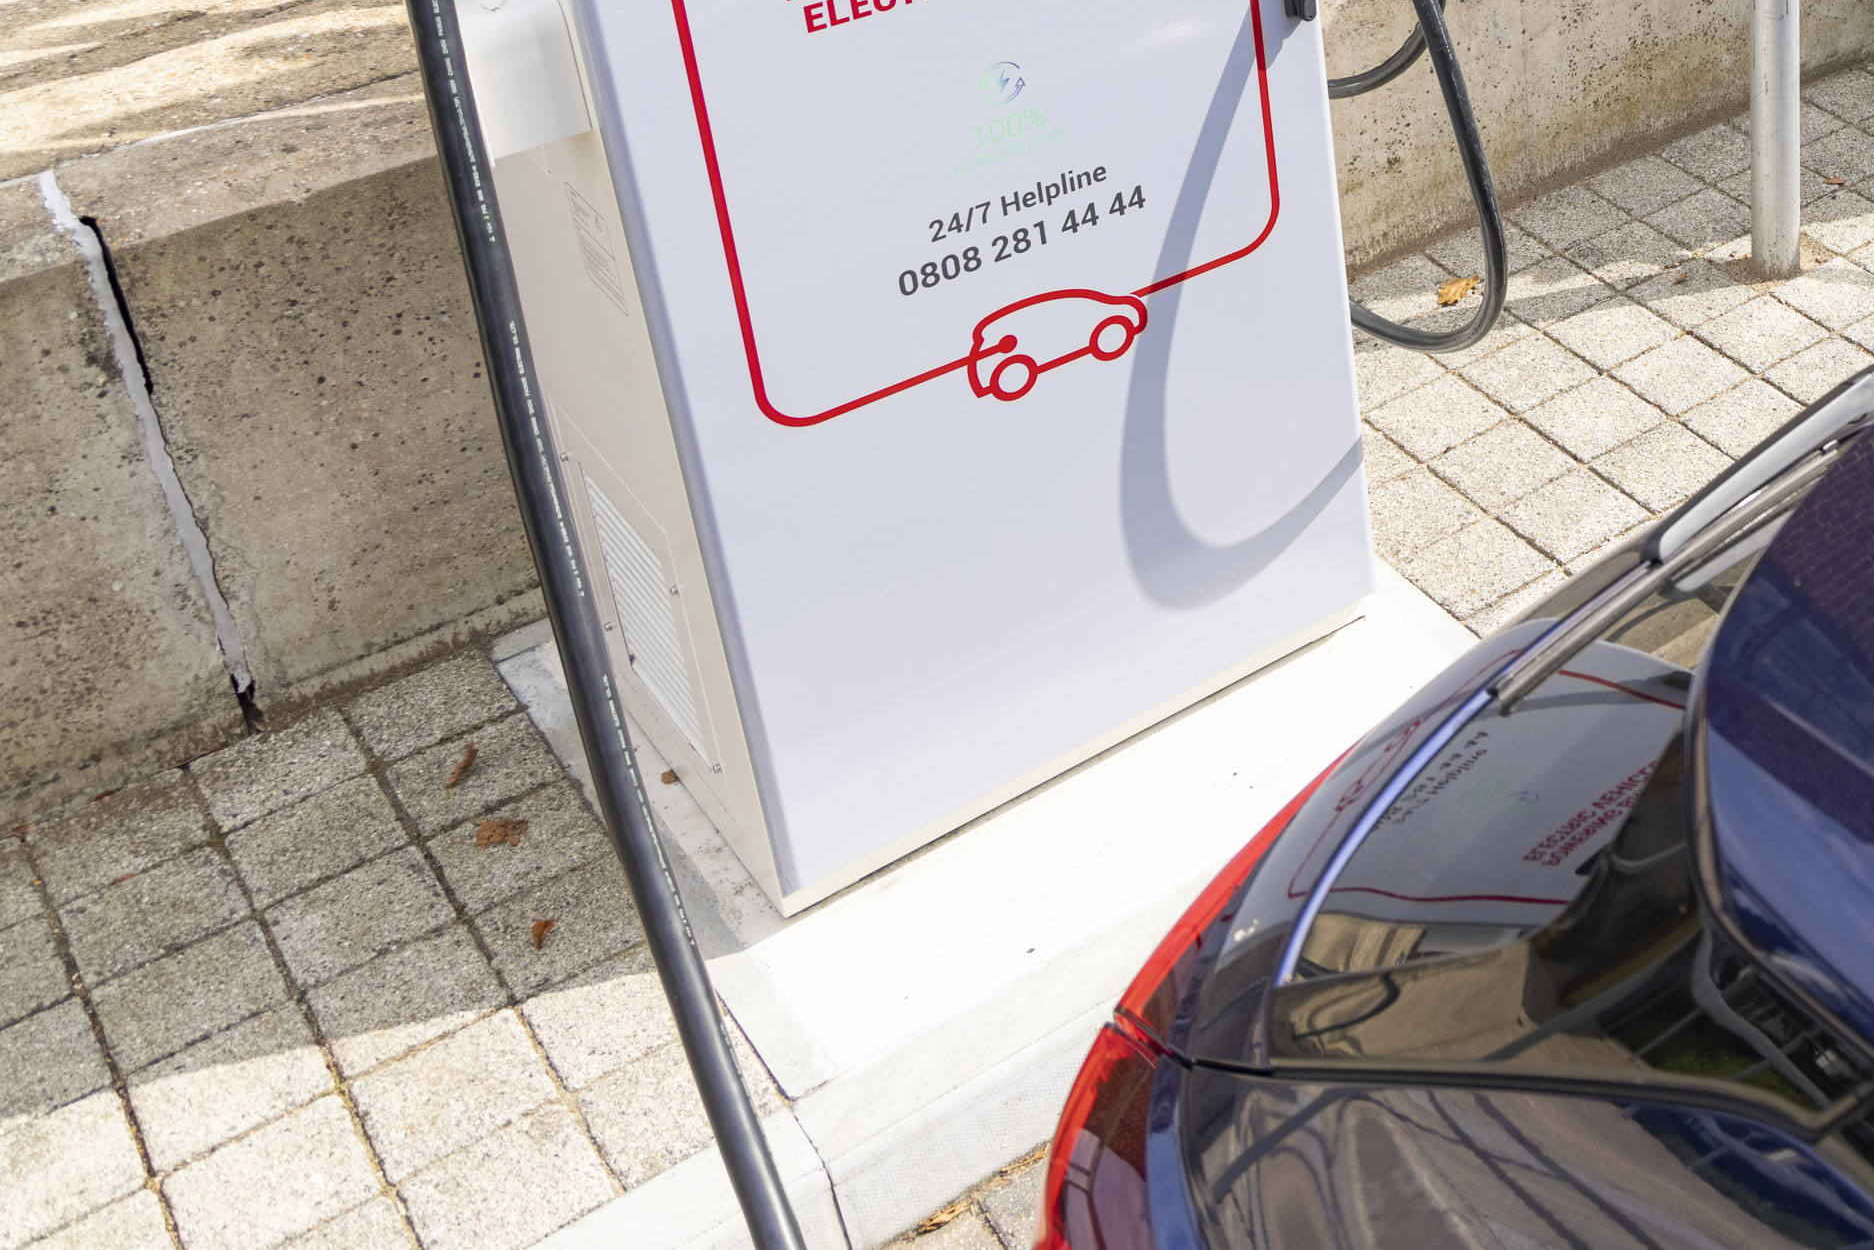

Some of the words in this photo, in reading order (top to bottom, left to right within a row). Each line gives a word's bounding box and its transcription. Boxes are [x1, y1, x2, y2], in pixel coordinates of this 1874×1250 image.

[954, 142, 1024, 174] renewable
[1028, 126, 1069, 150] power
[973, 109, 1045, 147] 100%
[929, 201, 992, 242] 24/7
[1000, 165, 1107, 218] Helpline
[899, 247, 982, 297] 0808
[992, 220, 1048, 262] 281
[1061, 202, 1099, 235] 44
[1109, 185, 1145, 217] 44
